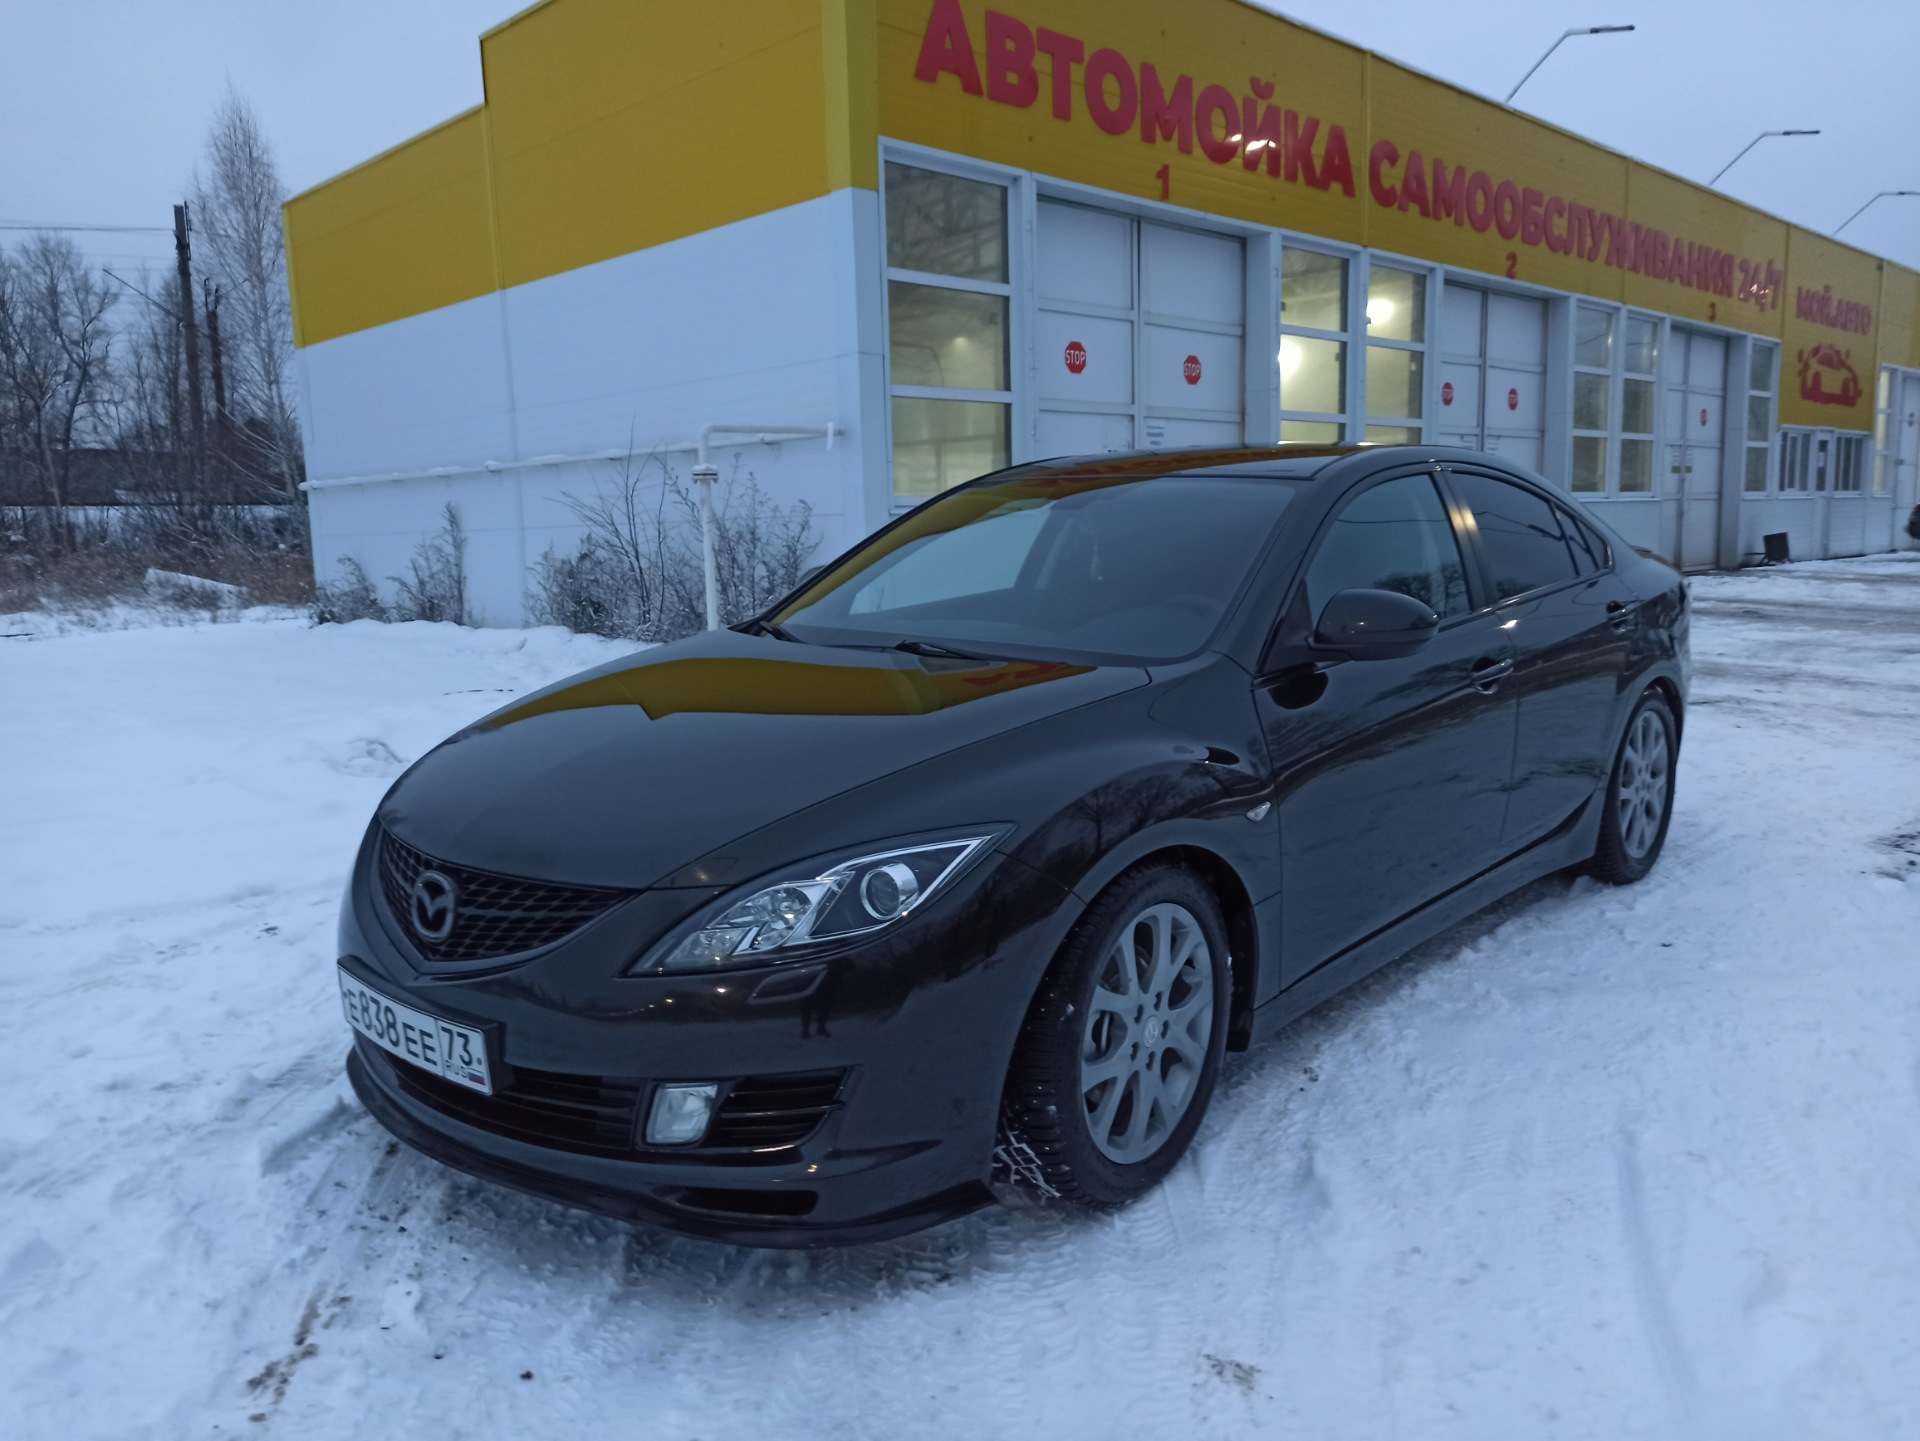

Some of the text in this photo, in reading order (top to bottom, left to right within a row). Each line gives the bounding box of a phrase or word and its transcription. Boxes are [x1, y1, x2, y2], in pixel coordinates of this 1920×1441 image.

[915, 0, 1356, 198] АВТОМОЙКА
[1369, 139, 1735, 299] САМООБСЛУЖИВАНИЯ
[1155, 164, 1171, 200] 1
[1505, 251, 1518, 280] 2
[1065, 349, 1086, 365] STOP
[1183, 363, 1201, 377] STOP
[440, 1025, 473, 1067] 73
[445, 1058, 469, 1079] RUS
